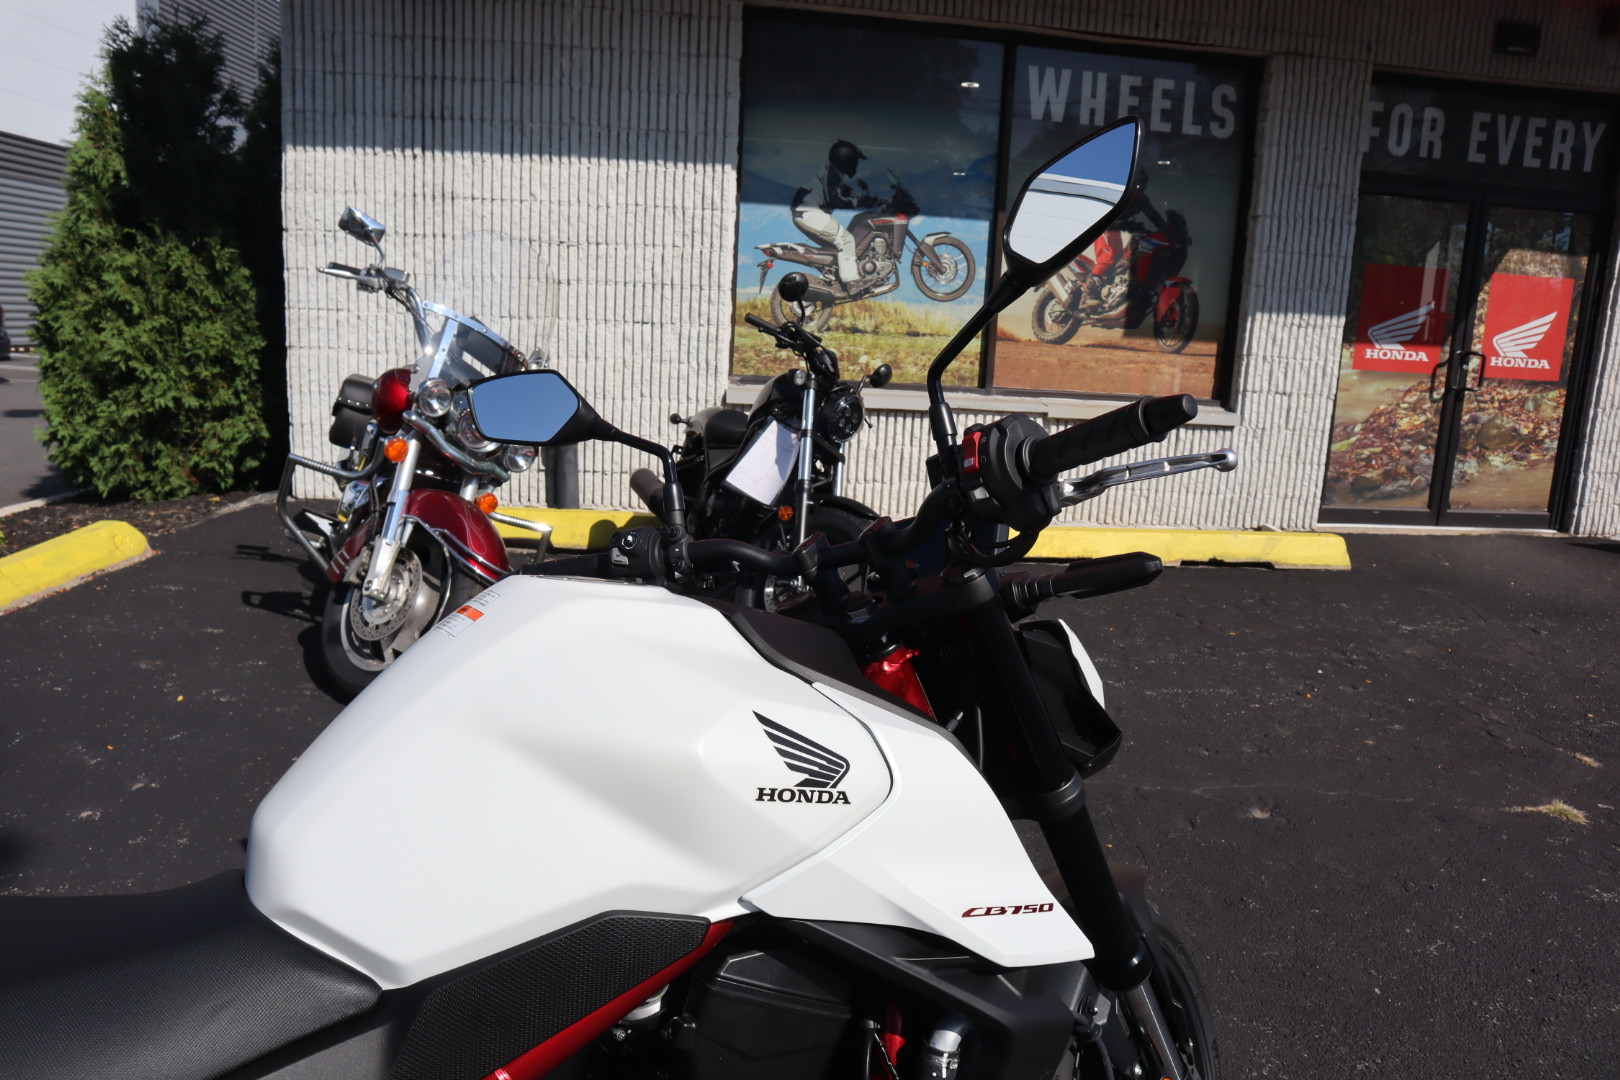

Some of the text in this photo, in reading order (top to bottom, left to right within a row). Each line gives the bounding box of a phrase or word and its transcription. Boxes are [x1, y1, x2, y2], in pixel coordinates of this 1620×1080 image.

[1028, 65, 1238, 139] WHEELS
[1362, 101, 1606, 172] FOR EVERY
[1364, 348, 1429, 362] HONDA
[1490, 356, 1550, 370] HONDA
[755, 787, 851, 804] HONDA
[962, 903, 1054, 918] CB750
